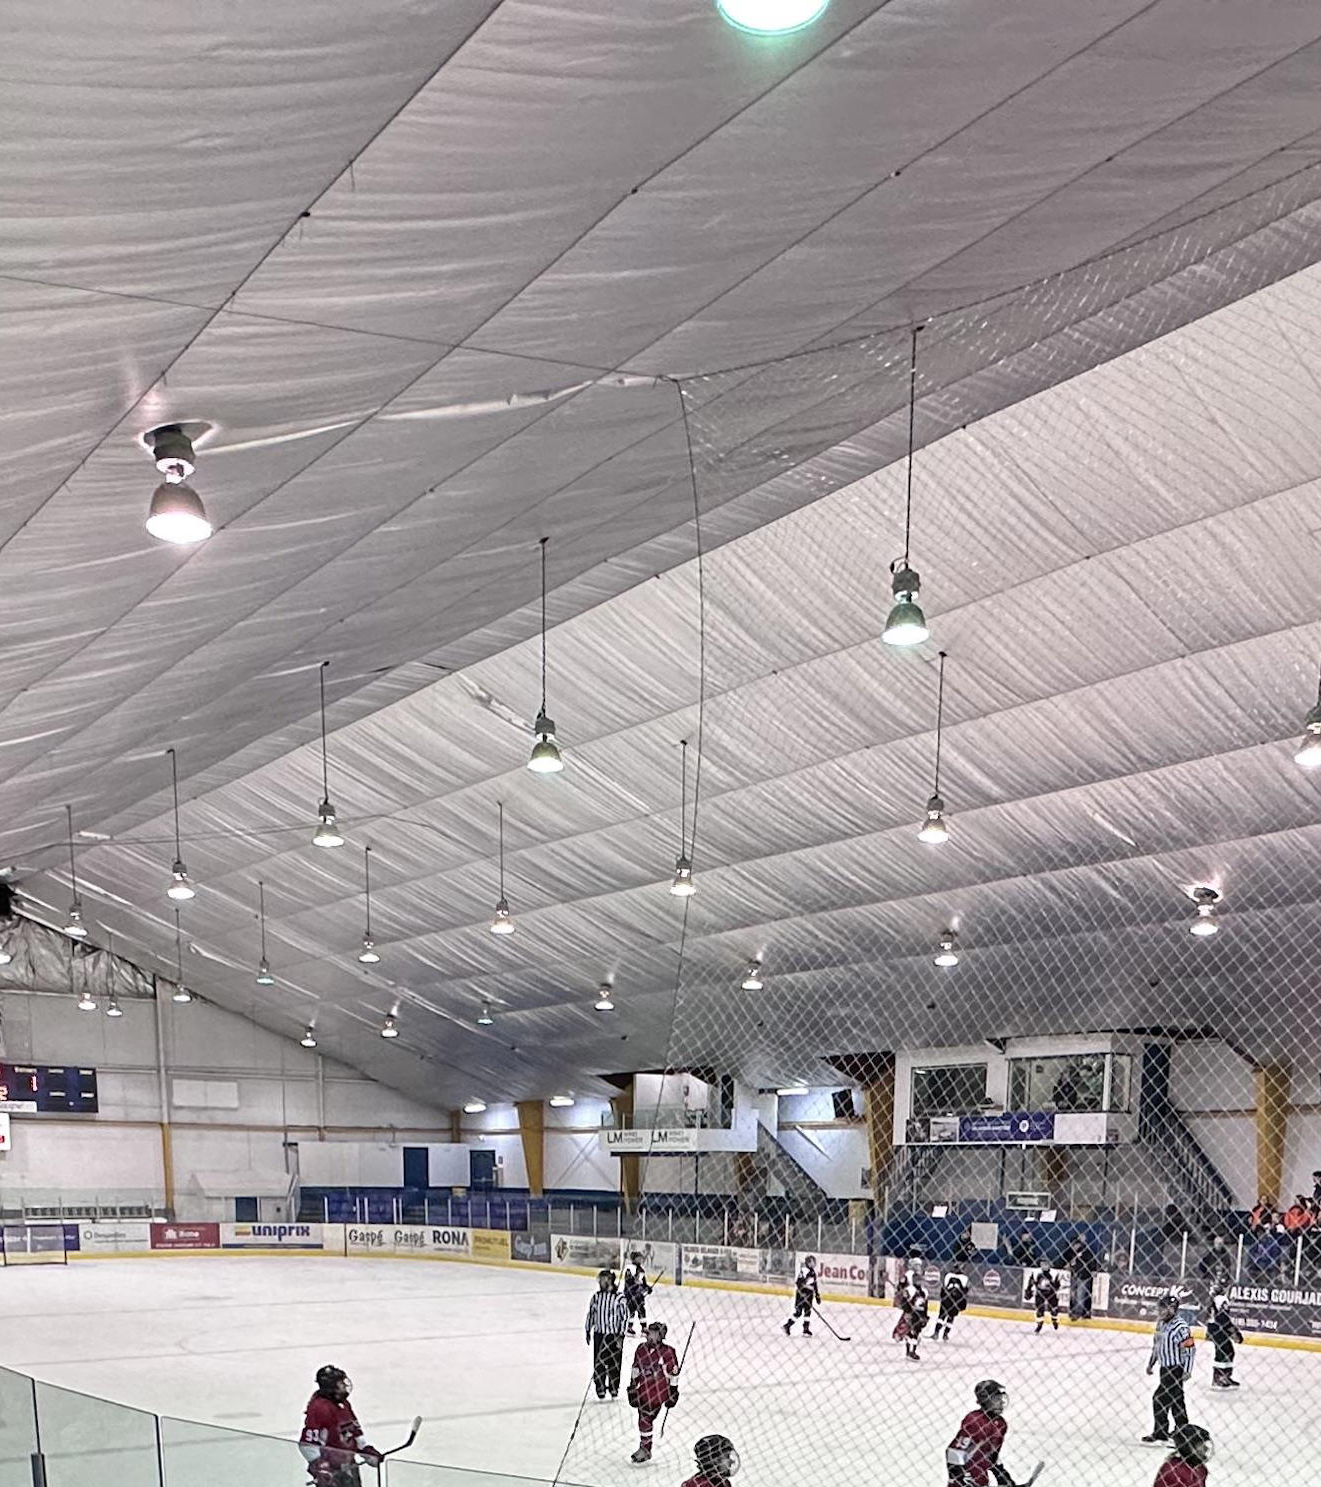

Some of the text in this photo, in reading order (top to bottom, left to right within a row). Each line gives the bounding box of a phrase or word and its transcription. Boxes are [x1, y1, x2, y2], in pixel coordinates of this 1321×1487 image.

[31, 1075, 38, 1091] 1
[607, 1131, 623, 1144] LM
[651, 1131, 667, 1143] LM
[252, 1225, 310, 1242] uniprix
[349, 1229, 384, 1245] Gaspé
[394, 1229, 425, 1246] Gaspé
[432, 1230, 469, 1245] RONA
[818, 1262, 848, 1279] Jean
[1121, 1284, 1170, 1298] CONCEPT
[1229, 1286, 1269, 1301] ALEXIS
